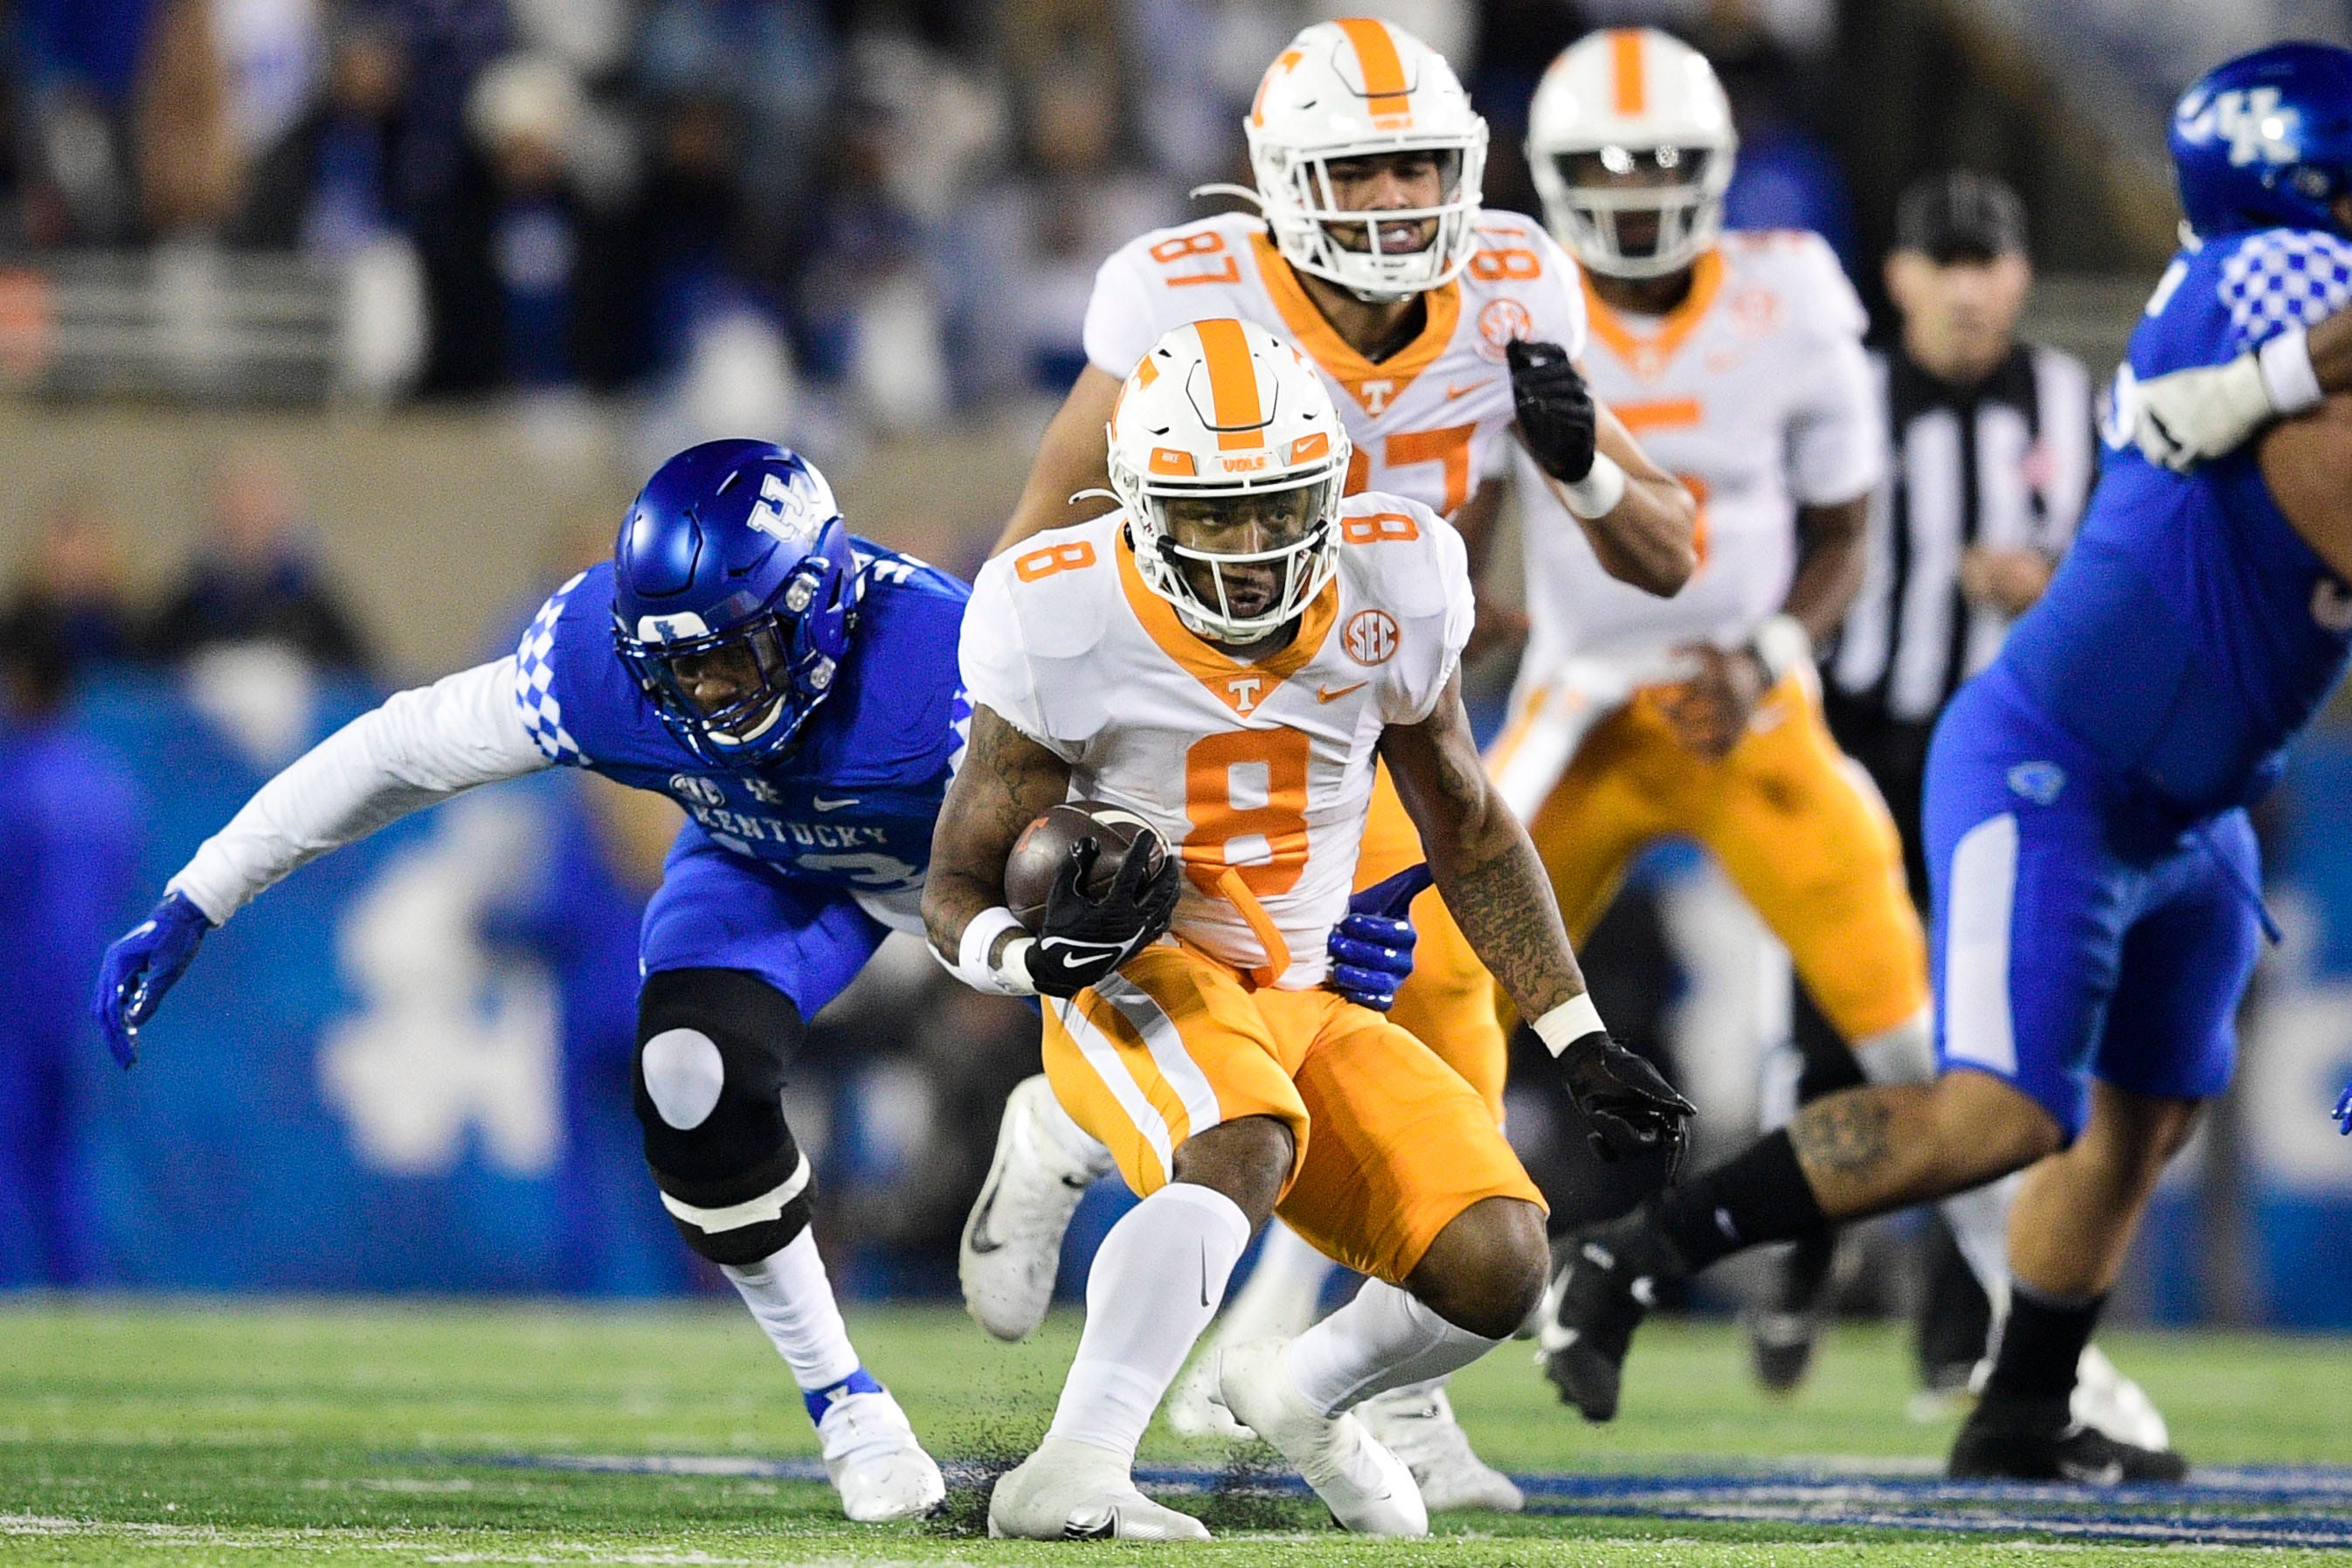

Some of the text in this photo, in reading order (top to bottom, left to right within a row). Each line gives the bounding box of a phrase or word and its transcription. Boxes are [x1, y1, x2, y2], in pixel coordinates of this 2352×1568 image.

[1150, 231, 1241, 287] 87
[1361, 379, 1394, 414] T
[1223, 456, 1266, 473] VOLS
[1343, 422, 1480, 519] 7
[1340, 513, 1420, 543] 8
[1015, 540, 1096, 583] 8
[1348, 611, 1396, 662] SEC
[1228, 677, 1261, 711] T
[690, 803, 887, 847] KENTUCKY
[1181, 727, 1311, 898] 8
